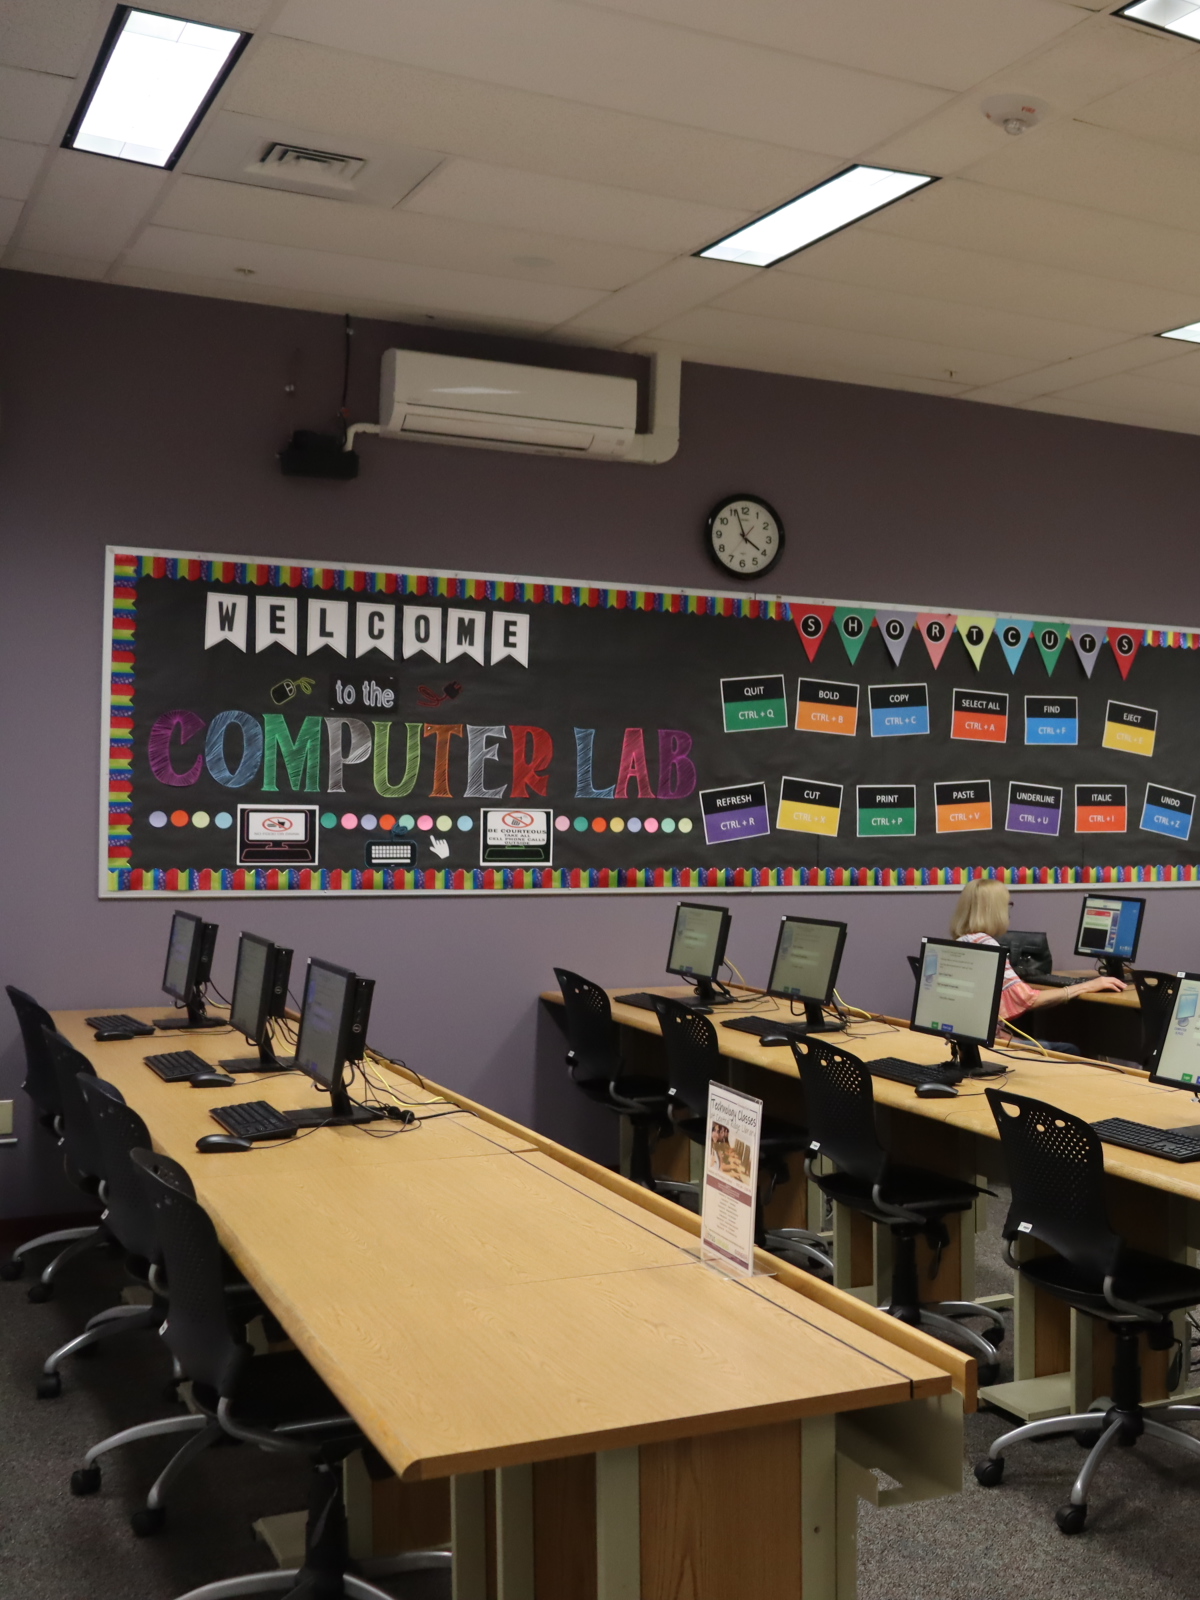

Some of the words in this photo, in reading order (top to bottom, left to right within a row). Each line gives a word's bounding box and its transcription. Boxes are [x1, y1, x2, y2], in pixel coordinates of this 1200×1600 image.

[741, 507, 750, 515] 12
[720, 517, 728, 525] 10
[763, 522, 769, 530] 2
[716, 530, 722, 538] 9
[766, 536, 772, 544] 3
[719, 544, 725, 552] 8
[761, 549, 767, 557] 4
[729, 555, 734, 563] 7
[752, 557, 758, 566] 5
[739, 560, 745, 568] 6
[218, 601, 518, 648] WELCOME
[807, 618, 1128, 651] SHORTCUTS
[336, 680, 356, 705] to
[362, 680, 395, 708] the
[744, 686, 764, 696] QUIT
[819, 690, 840, 700] BOLD
[889, 694, 910, 703] COPY
[962, 699, 987, 709] SELECT
[988, 702, 1000, 710] ALL
[738, 710, 758, 719] CTRL
[767, 709, 774, 718] Q
[811, 712, 830, 722] CTRL
[838, 715, 844, 723] B
[1123, 712, 1141, 723] EJECT
[885, 717, 904, 725] CTRL
[911, 716, 916, 724] C
[965, 722, 983, 730] CTRL
[1038, 727, 1055, 735] CTRL
[148, 709, 554, 799] COMPUTER
[573, 726, 698, 800] LAB
[804, 790, 821, 800] CUT
[876, 795, 899, 803] PRINT
[953, 791, 975, 799] PASTE
[1016, 792, 1055, 804] UNDERLINE
[1091, 793, 1112, 802] ITALIC
[716, 794, 752, 807] REFRESH
[1161, 796, 1180, 807] UNDO
[793, 812, 812, 822] CTRL
[820, 815, 826, 824] X
[949, 813, 967, 821] CTRL
[974, 812, 980, 820] V
[1019, 814, 1036, 823] CTRL
[1043, 816, 1049, 824] U
[1089, 815, 1105, 823] CTRL
[720, 820, 740, 830] CTRL
[749, 817, 755, 825] R
[871, 817, 890, 826] CTRL
[898, 817, 903, 825] P
[1154, 815, 1170, 826] CTRL
[1174, 820, 1180, 828] Z
[711, 1098, 736, 1124] Technology
[738, 1110, 756, 1128] Classes
